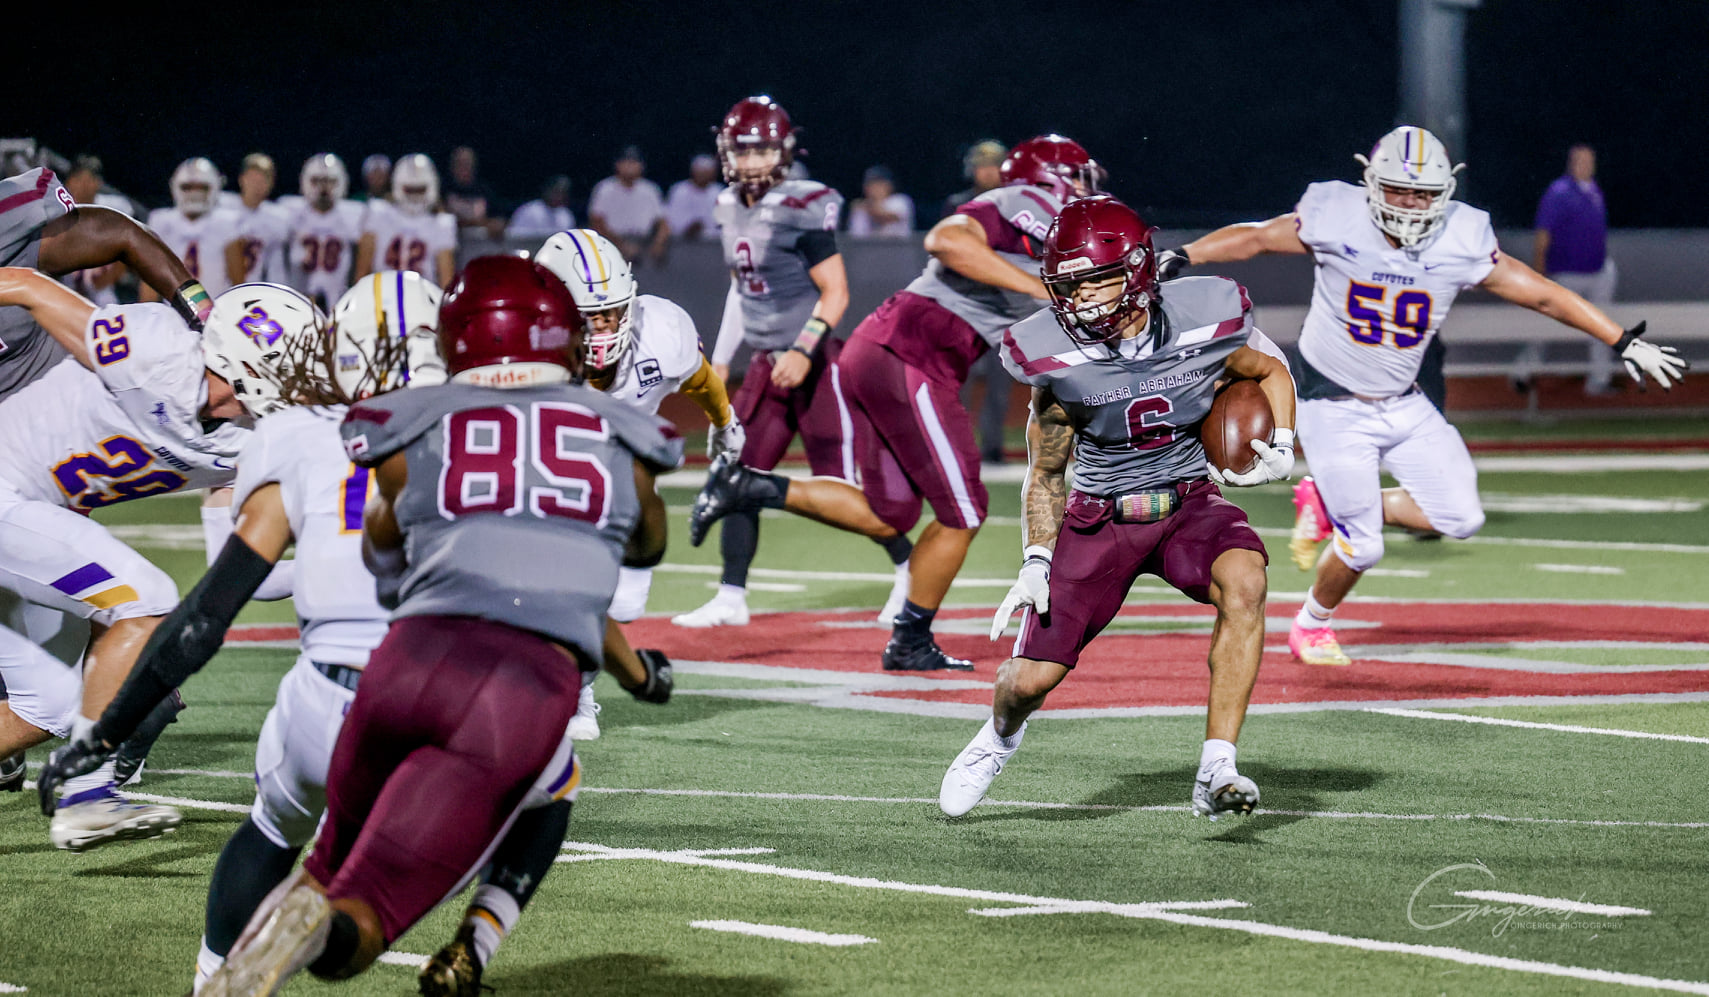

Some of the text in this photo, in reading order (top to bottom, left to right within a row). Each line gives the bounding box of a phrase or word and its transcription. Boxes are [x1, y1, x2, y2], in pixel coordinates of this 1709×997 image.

[385, 235, 426, 274] 42
[1372, 271, 1415, 285] COYOTES
[93, 313, 131, 367] 29
[1346, 278, 1433, 349] 59
[1082, 386, 1132, 406] FATHER
[1124, 393, 1177, 451] 6
[437, 401, 613, 529] 85
